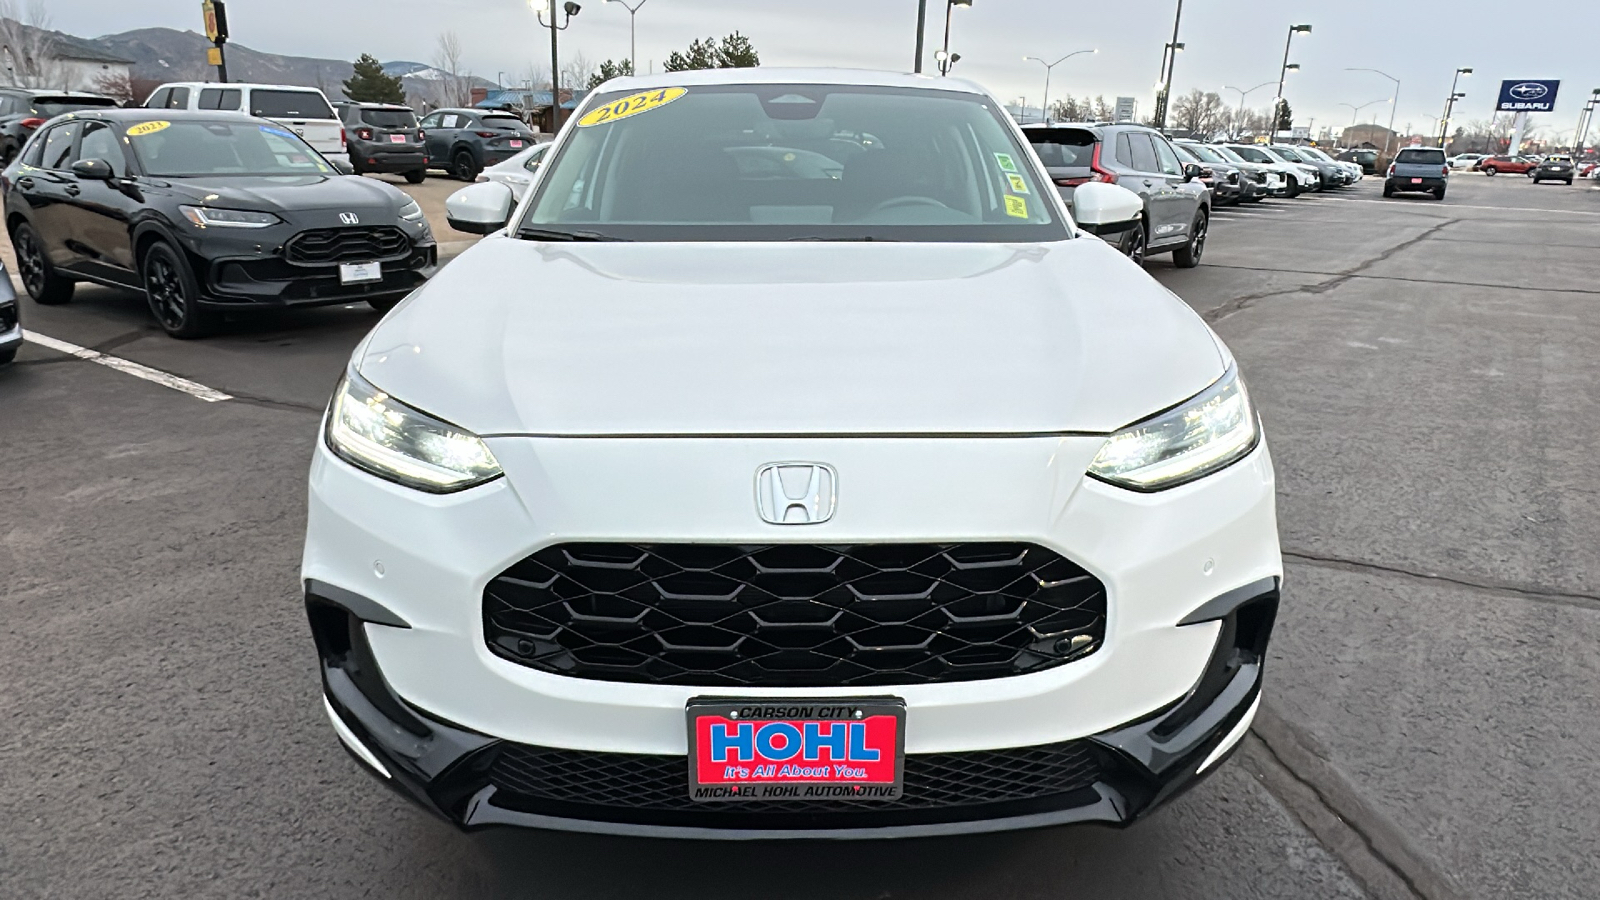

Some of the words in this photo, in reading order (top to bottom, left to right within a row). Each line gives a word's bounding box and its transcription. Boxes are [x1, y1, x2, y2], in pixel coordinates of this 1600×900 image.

[596, 89, 668, 123] 2024
[1501, 102, 1550, 110] SUBARU
[136, 121, 165, 134] 2023
[739, 706, 814, 719] CARSON
[818, 706, 857, 718] CITY
[710, 722, 881, 762] HOHL
[724, 765, 749, 778] It's
[752, 765, 776, 778] All
[779, 765, 830, 778] About
[833, 764, 868, 778] You.
[695, 786, 758, 798] MICHAEL
[762, 786, 801, 797] HOHL
[804, 786, 898, 797] AUTOMOTIVE
